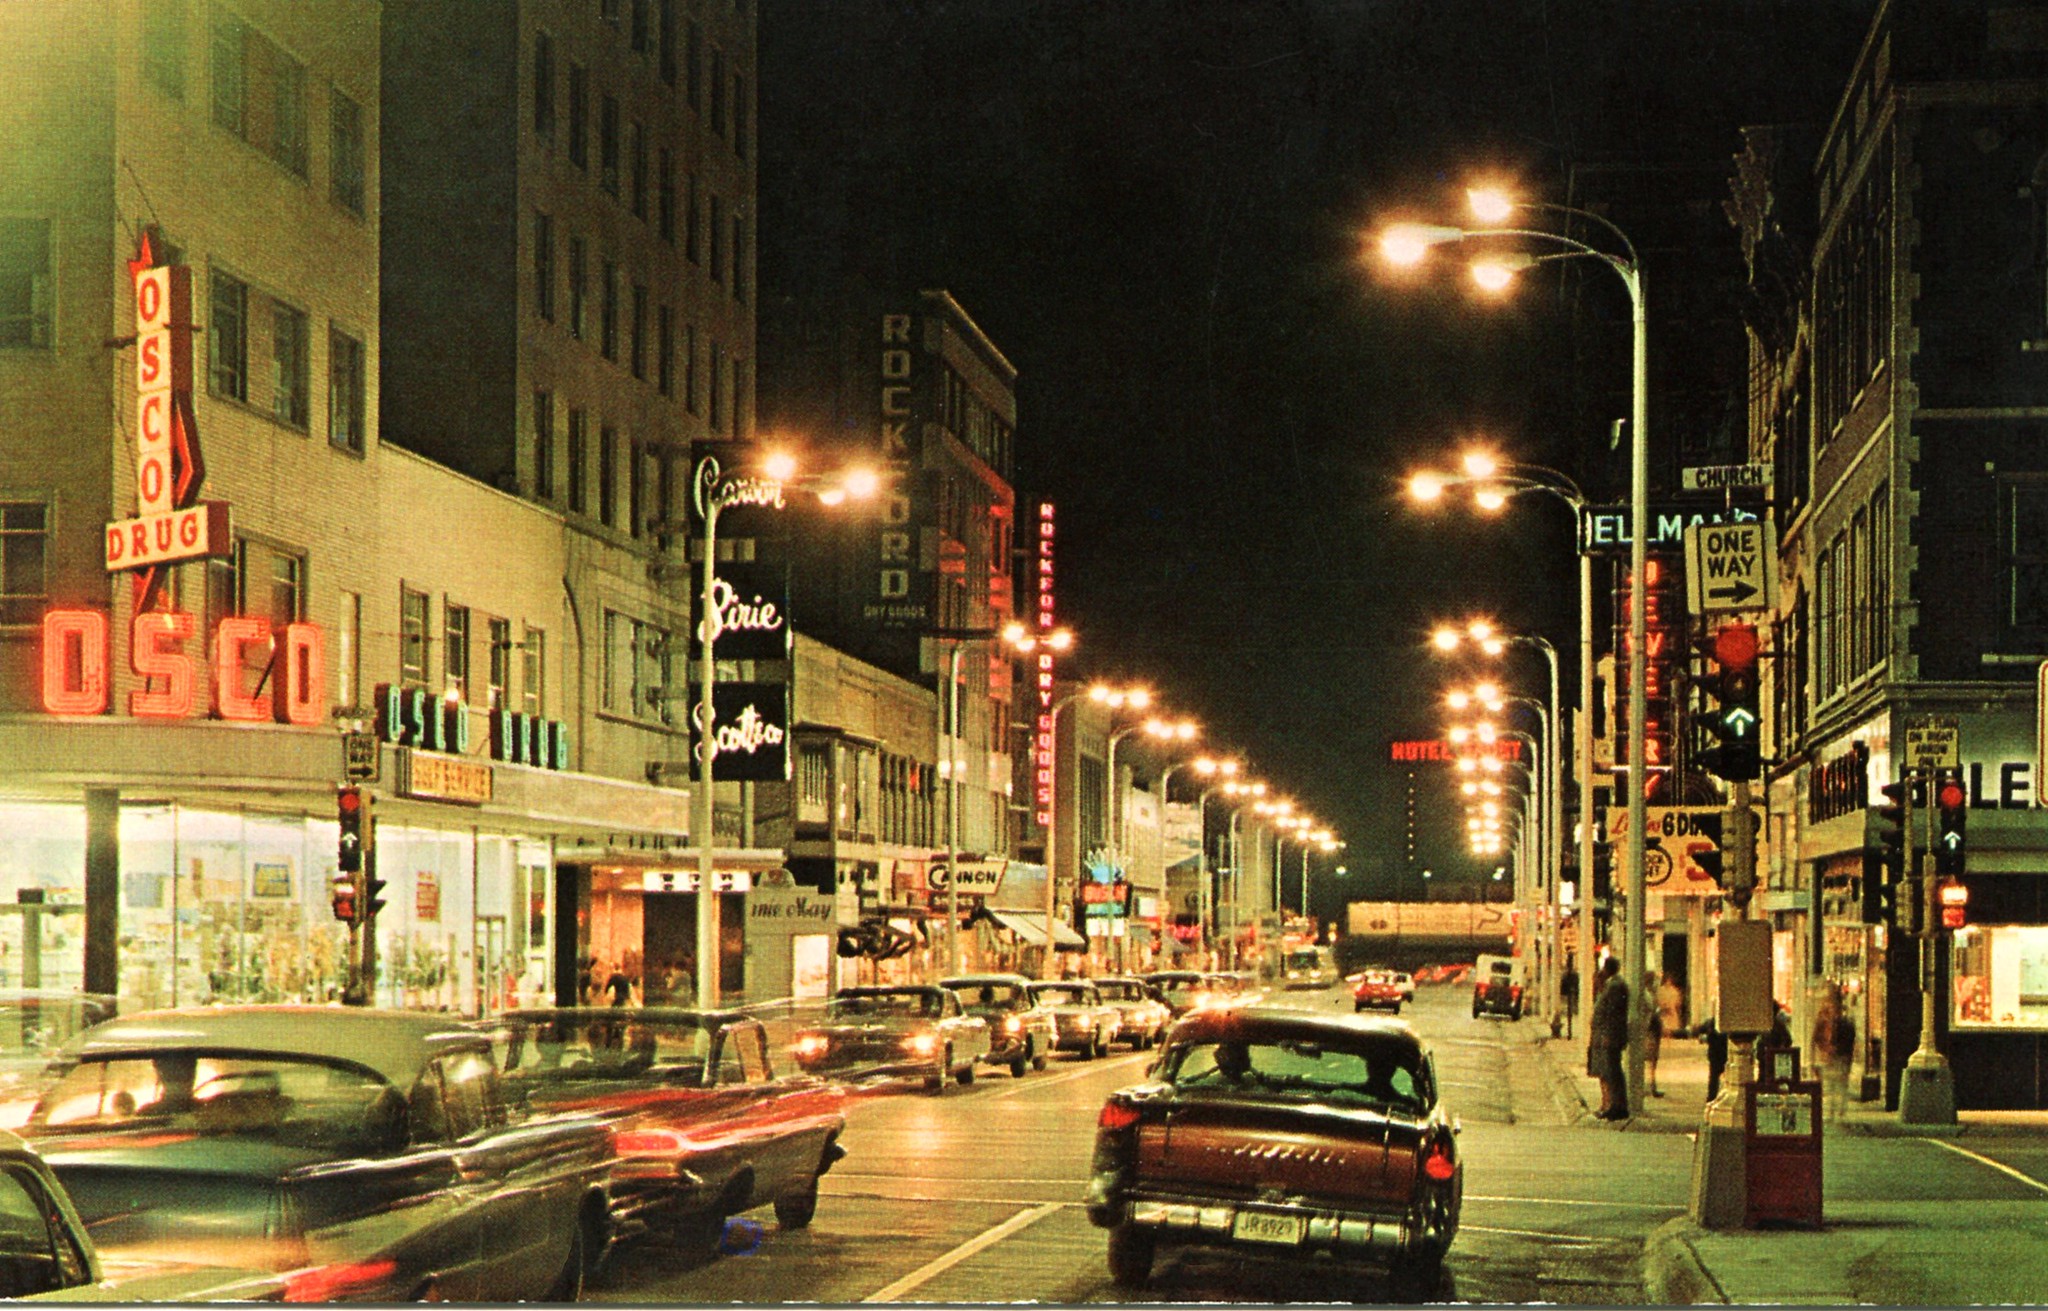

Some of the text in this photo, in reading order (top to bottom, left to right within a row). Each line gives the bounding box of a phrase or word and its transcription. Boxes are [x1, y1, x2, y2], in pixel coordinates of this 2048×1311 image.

[138, 276, 164, 505] OSCO
[1695, 465, 1763, 488] CHURCH
[108, 513, 200, 562] DRUG
[1707, 530, 1755, 554] ONE
[1707, 555, 1756, 578] WAY
[43, 609, 326, 725] OSCO
[387, 684, 469, 754] OSCO
[350, 751, 373, 764] WAY
